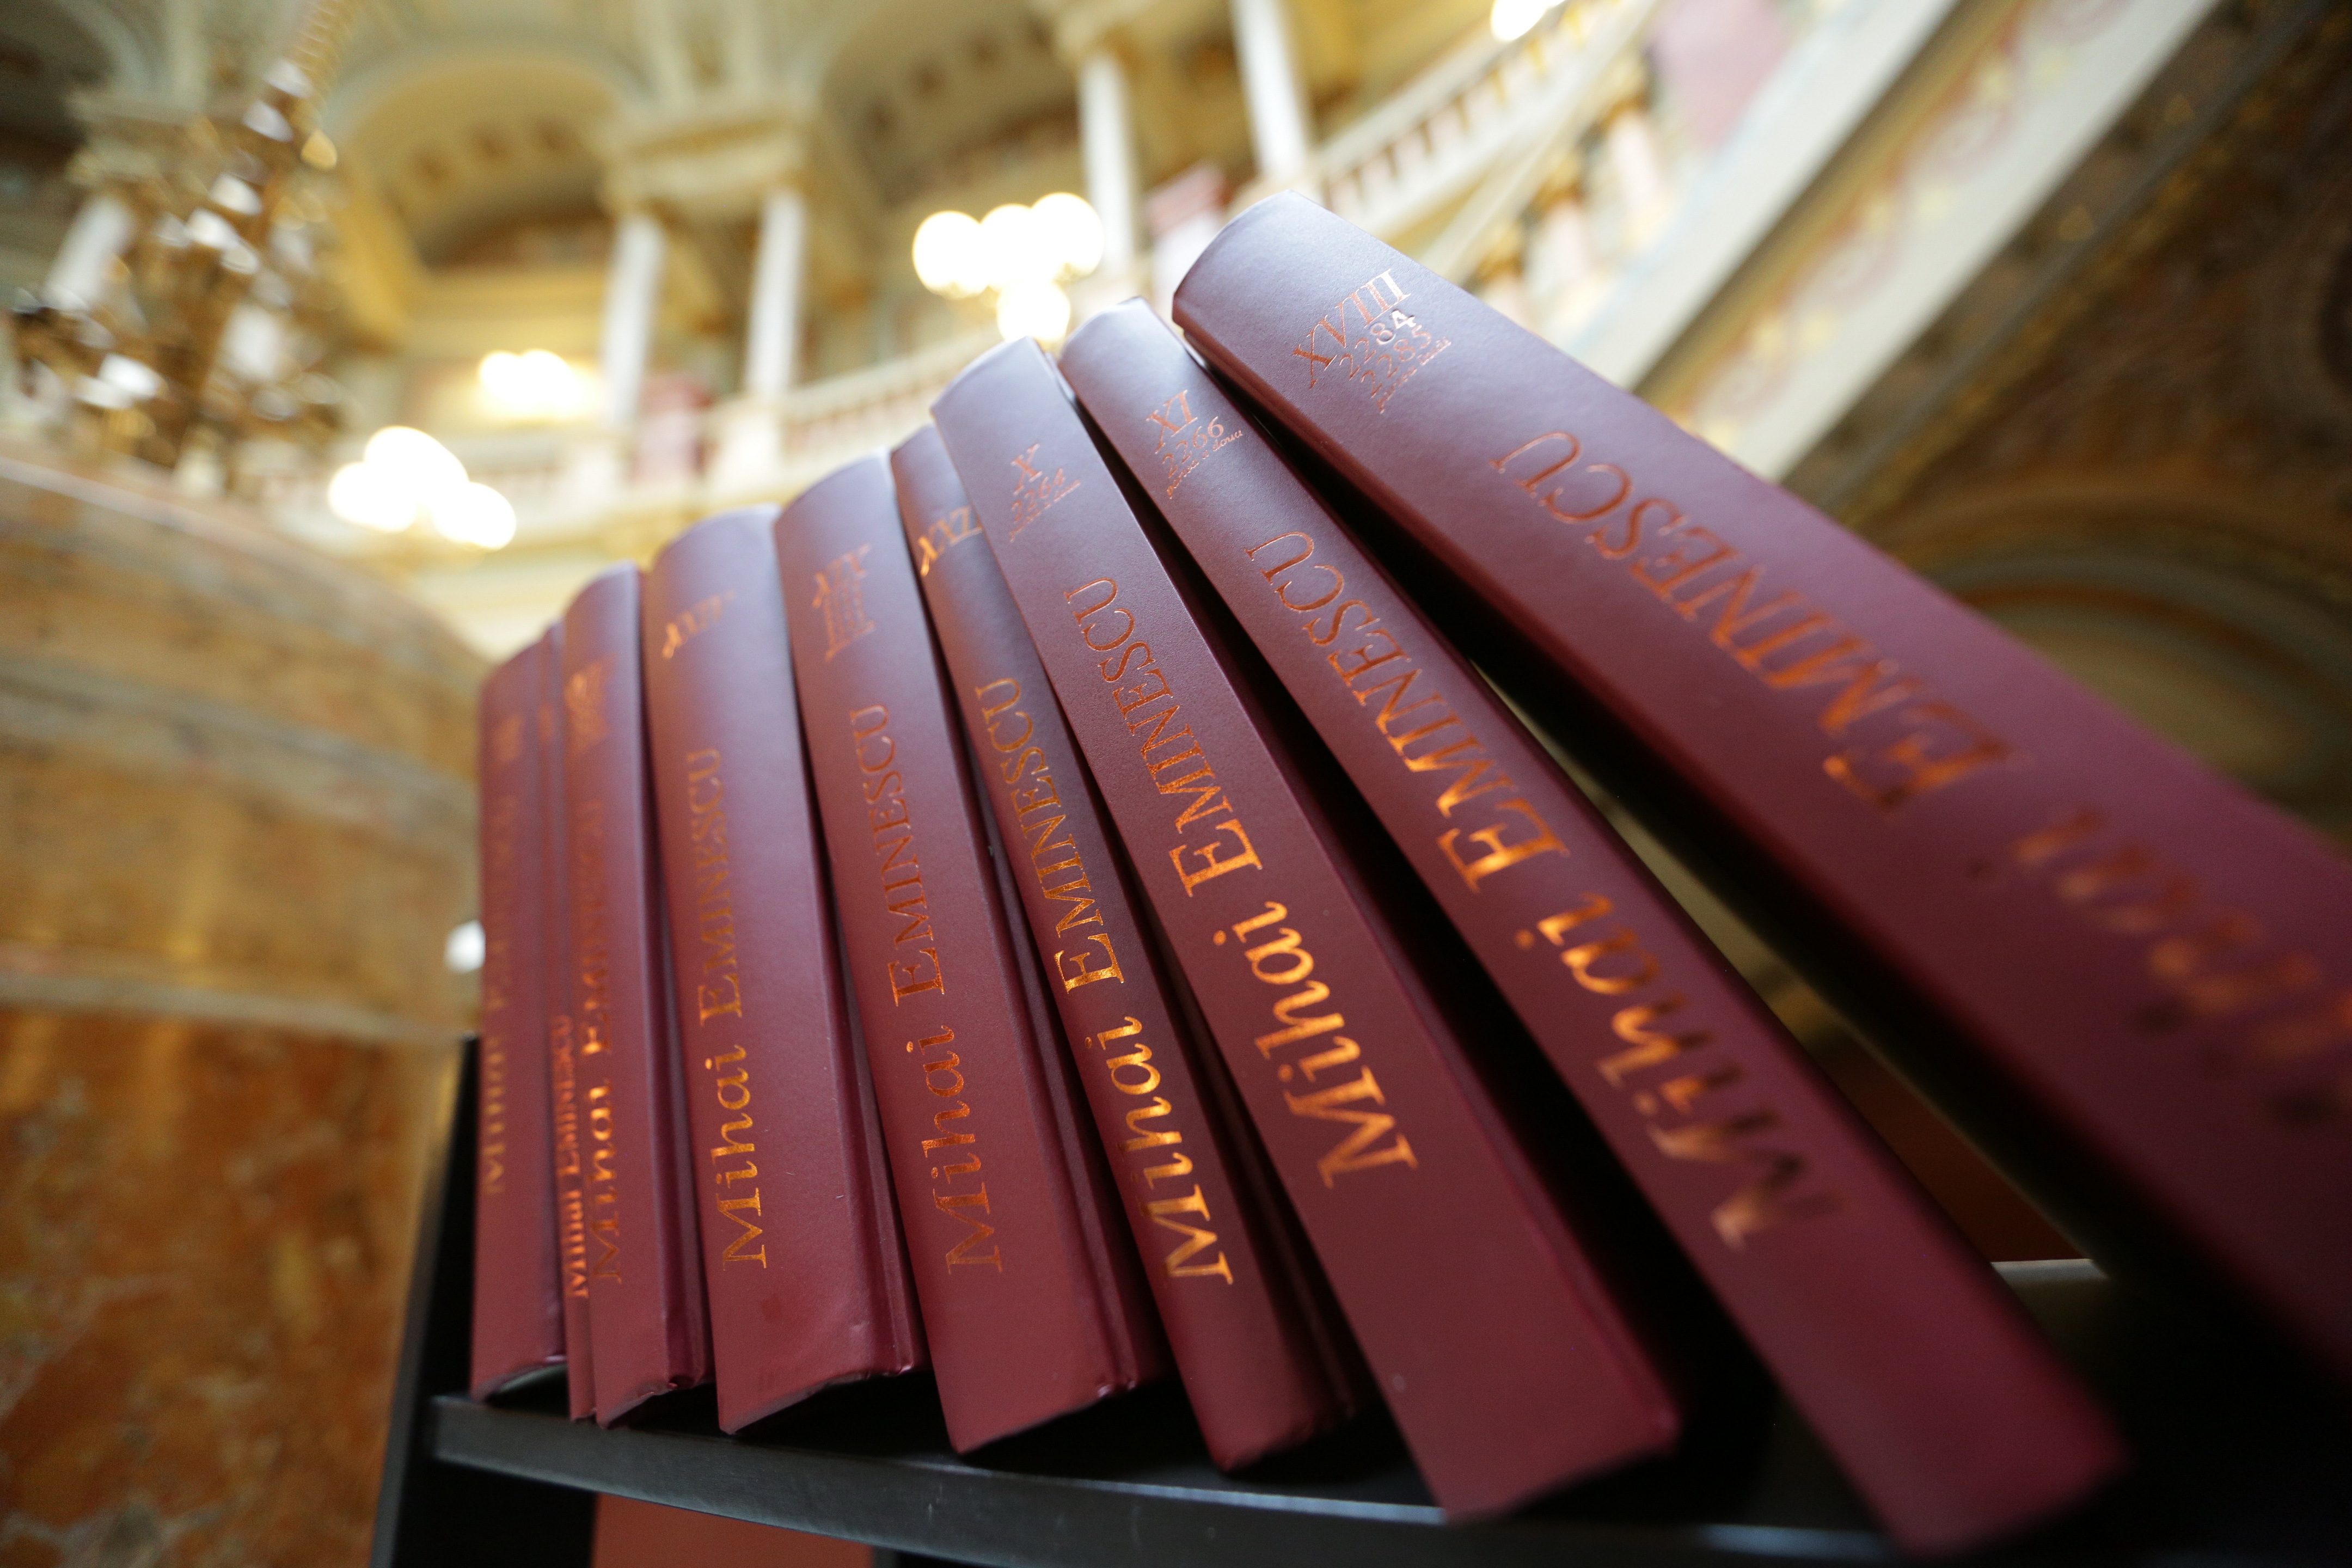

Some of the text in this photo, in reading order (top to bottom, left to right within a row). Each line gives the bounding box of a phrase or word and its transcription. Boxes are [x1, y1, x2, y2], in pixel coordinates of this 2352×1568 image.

[1146, 389, 1198, 455] XI
[1162, 416, 1224, 479] 2266
[1293, 268, 1411, 389] XVIII
[1339, 309, 1416, 381] 2284
[1361, 324, 1432, 398] 2285
[1010, 443, 1042, 496] X
[1246, 531, 1570, 893] EMINESCU
[1489, 431, 2014, 818] EMINESCU
[849, 705, 946, 1007] EMINESCU
[975, 677, 1124, 994] EMINESCU
[1063, 577, 1417, 1189] Mihai EMINESCU
[687, 748, 767, 1271] Mihai EMINESCU
[905, 1025, 1003, 1275] Mihai
[1084, 1016, 1233, 1285] Mihai
